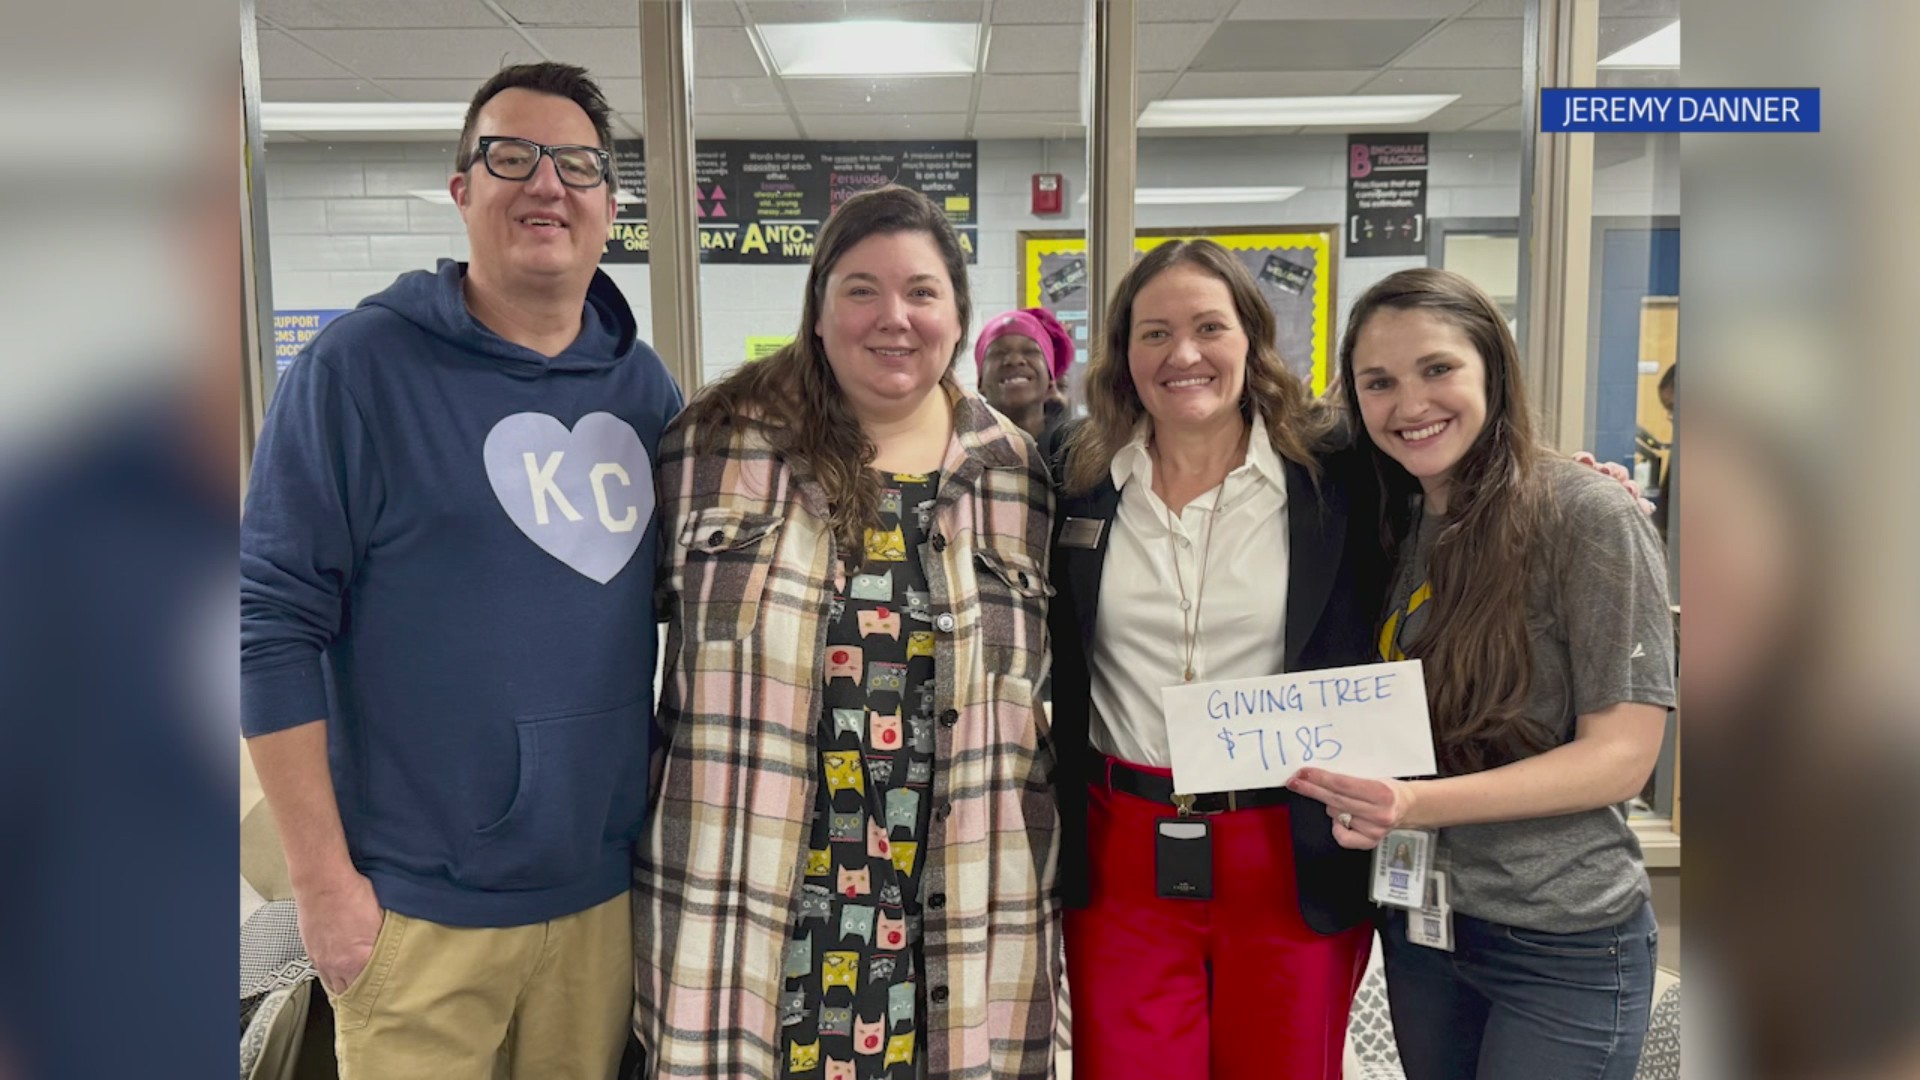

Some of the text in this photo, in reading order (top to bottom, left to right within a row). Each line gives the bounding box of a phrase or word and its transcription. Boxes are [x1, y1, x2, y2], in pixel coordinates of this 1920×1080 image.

[749, 152, 773, 160] Words
[821, 154, 833, 162] The
[902, 151, 909, 159] A
[955, 151, 972, 159] how
[926, 162, 950, 170] space
[951, 161, 972, 169] there
[923, 172, 936, 180] on
[936, 172, 944, 180] a
[945, 170, 959, 180] flat
[1206, 673, 1397, 720] GIVING TREE
[1216, 724, 1343, 770] $7185
